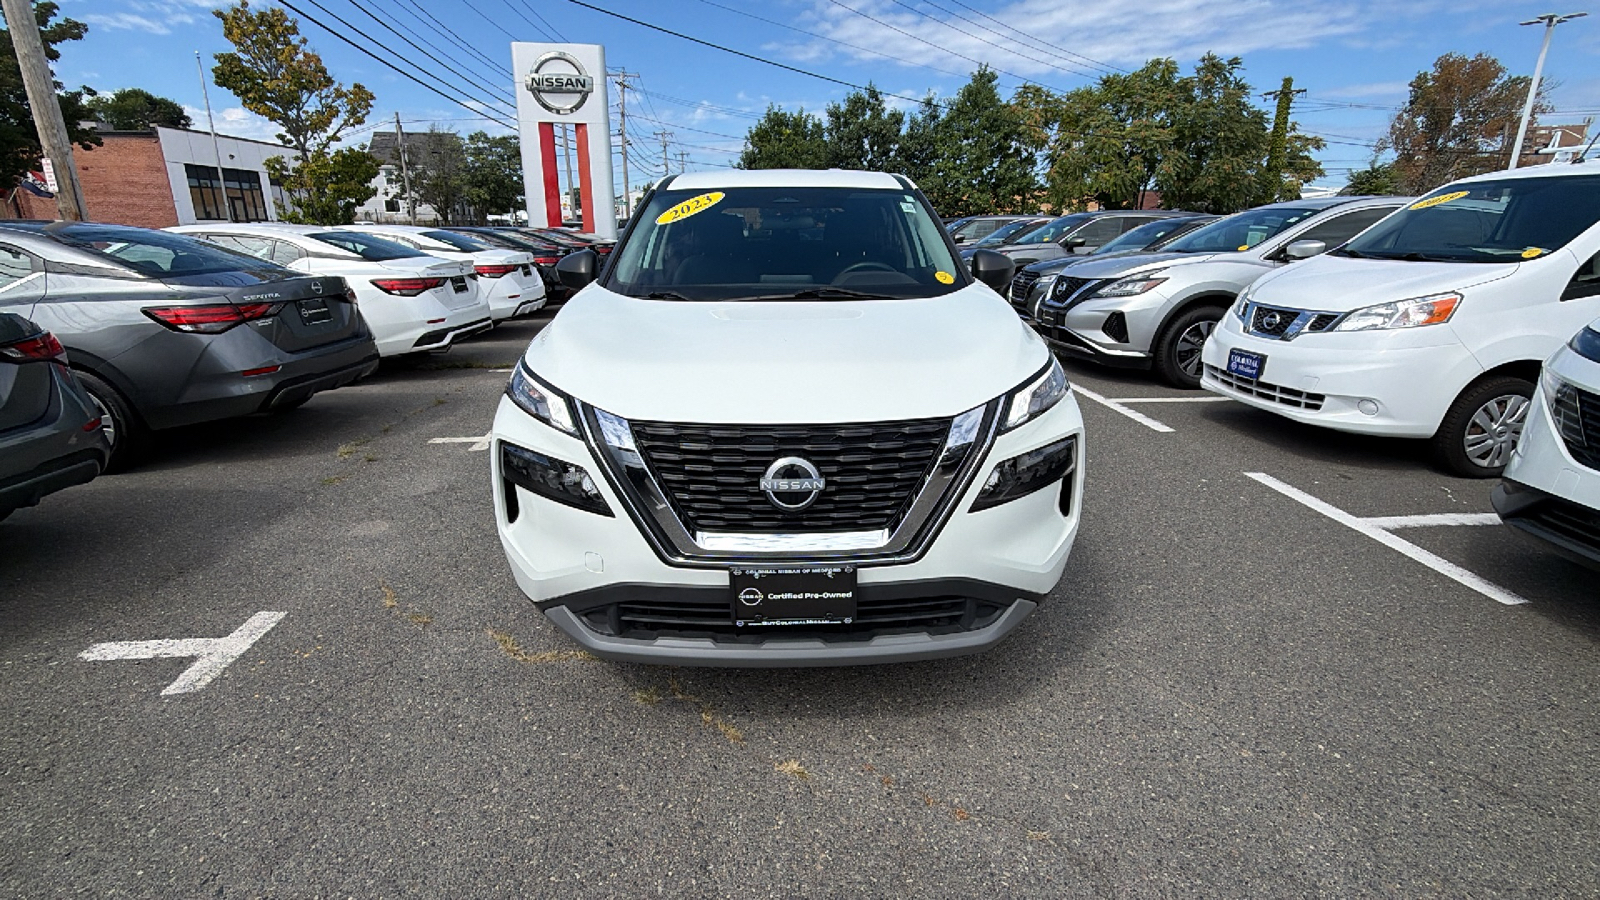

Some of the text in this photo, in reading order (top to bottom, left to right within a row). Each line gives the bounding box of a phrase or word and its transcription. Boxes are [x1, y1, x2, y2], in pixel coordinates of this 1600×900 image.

[531, 77, 586, 89] NISSAN
[669, 195, 713, 221] 2023
[243, 292, 281, 301] SENTRA
[761, 481, 823, 490] NISSAN
[767, 591, 852, 600] Certified Pre-Owned
